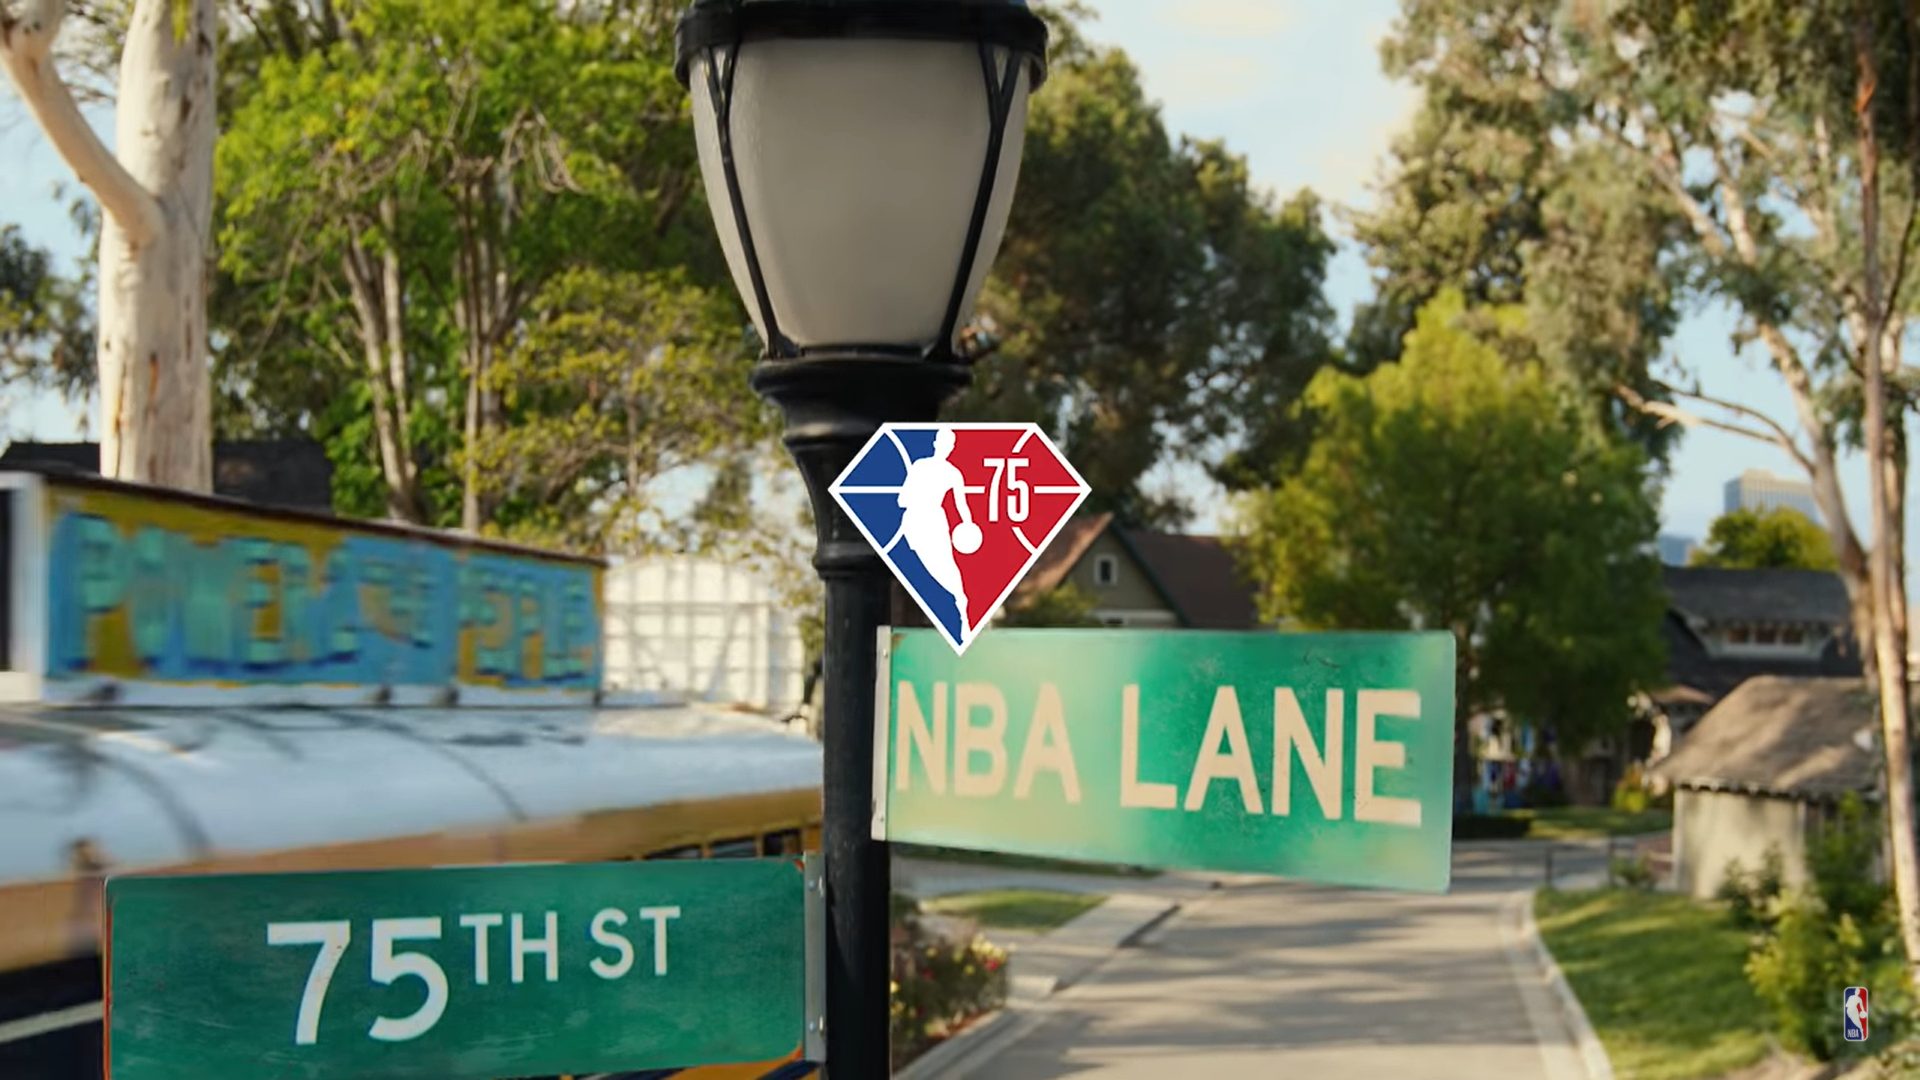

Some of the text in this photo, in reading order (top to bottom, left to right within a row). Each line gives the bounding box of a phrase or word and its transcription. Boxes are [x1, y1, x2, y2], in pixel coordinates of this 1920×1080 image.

[895, 680, 1421, 826] NBA LANE
[589, 905, 682, 979] ST
